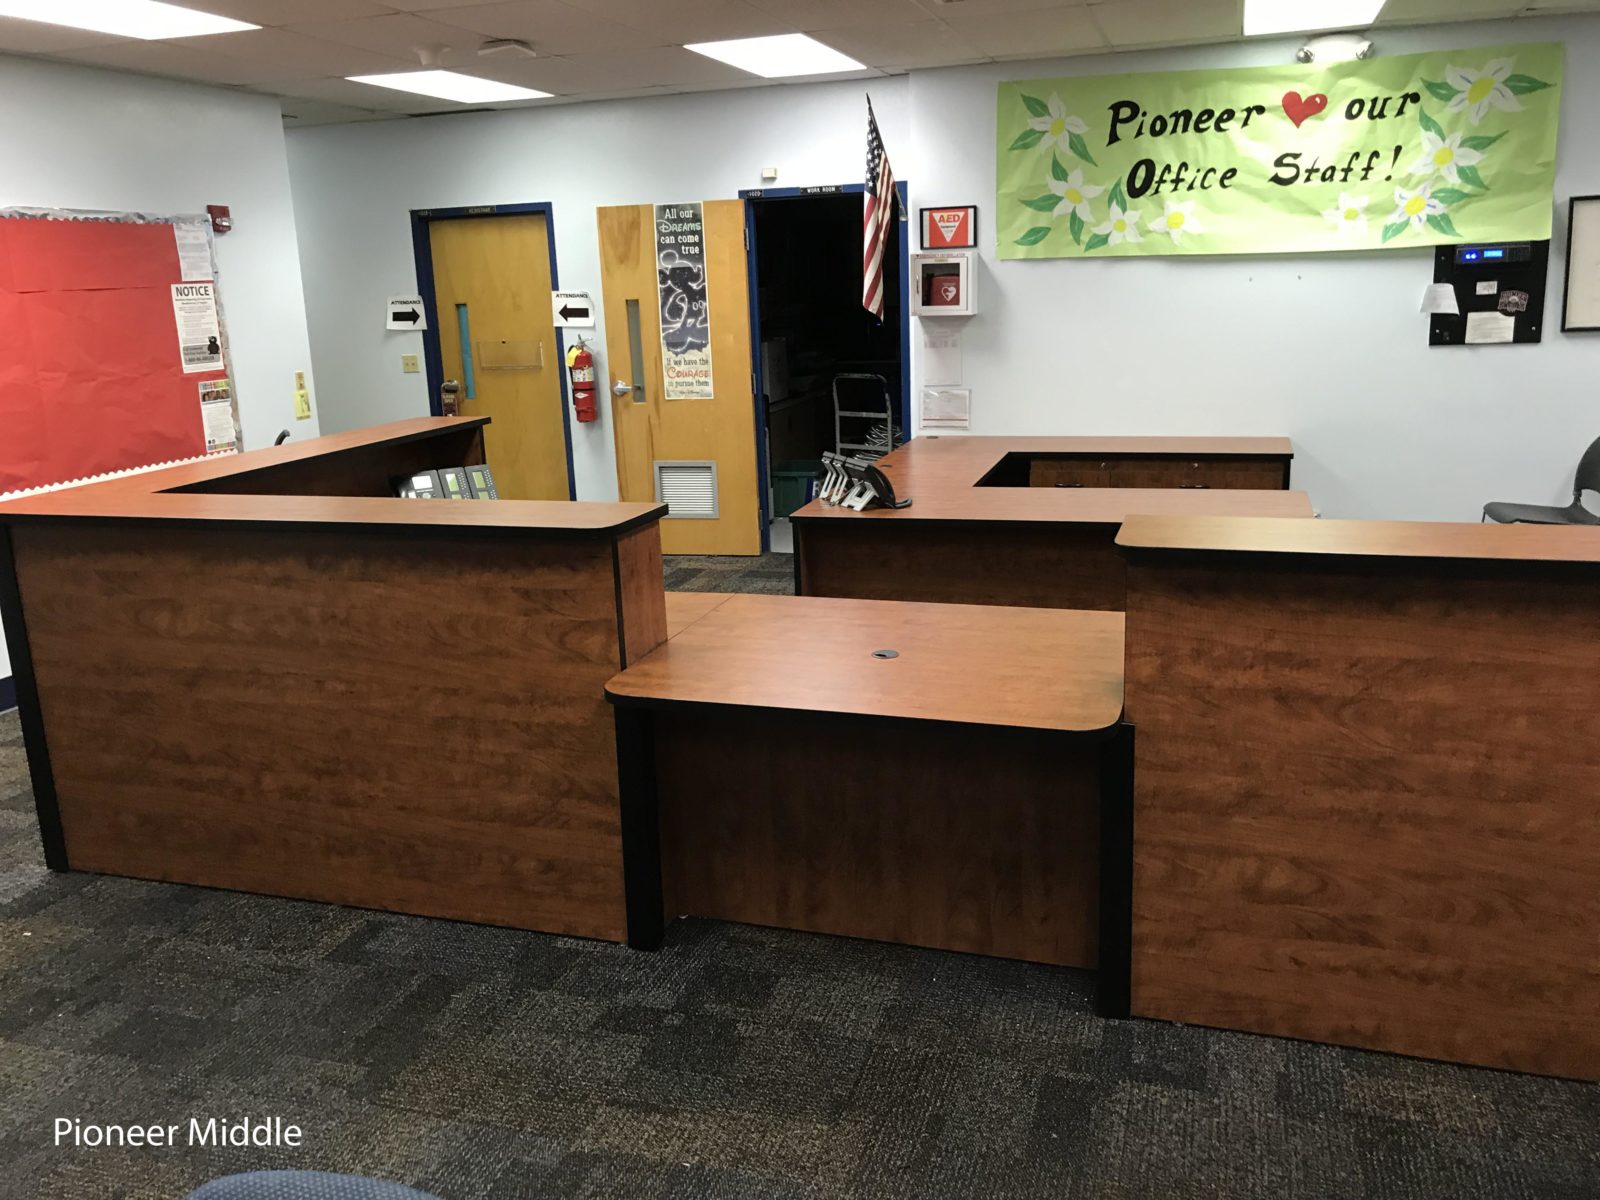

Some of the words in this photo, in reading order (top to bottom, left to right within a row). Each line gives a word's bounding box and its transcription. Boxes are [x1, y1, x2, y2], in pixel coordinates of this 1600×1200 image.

[1106, 99, 1266, 147] Pioneer
[1345, 91, 1421, 121] our
[1126, 158, 1238, 200] Office
[1267, 144, 1403, 187] Staff!
[664, 208, 677, 219] All
[679, 210, 694, 218] our
[938, 214, 961, 223] AED
[660, 235, 676, 244] can
[677, 234, 700, 243] come
[681, 245, 700, 254] true
[175, 285, 210, 297] NOTICE
[683, 357, 697, 366] have
[698, 356, 709, 366] the
[695, 379, 709, 387] them
